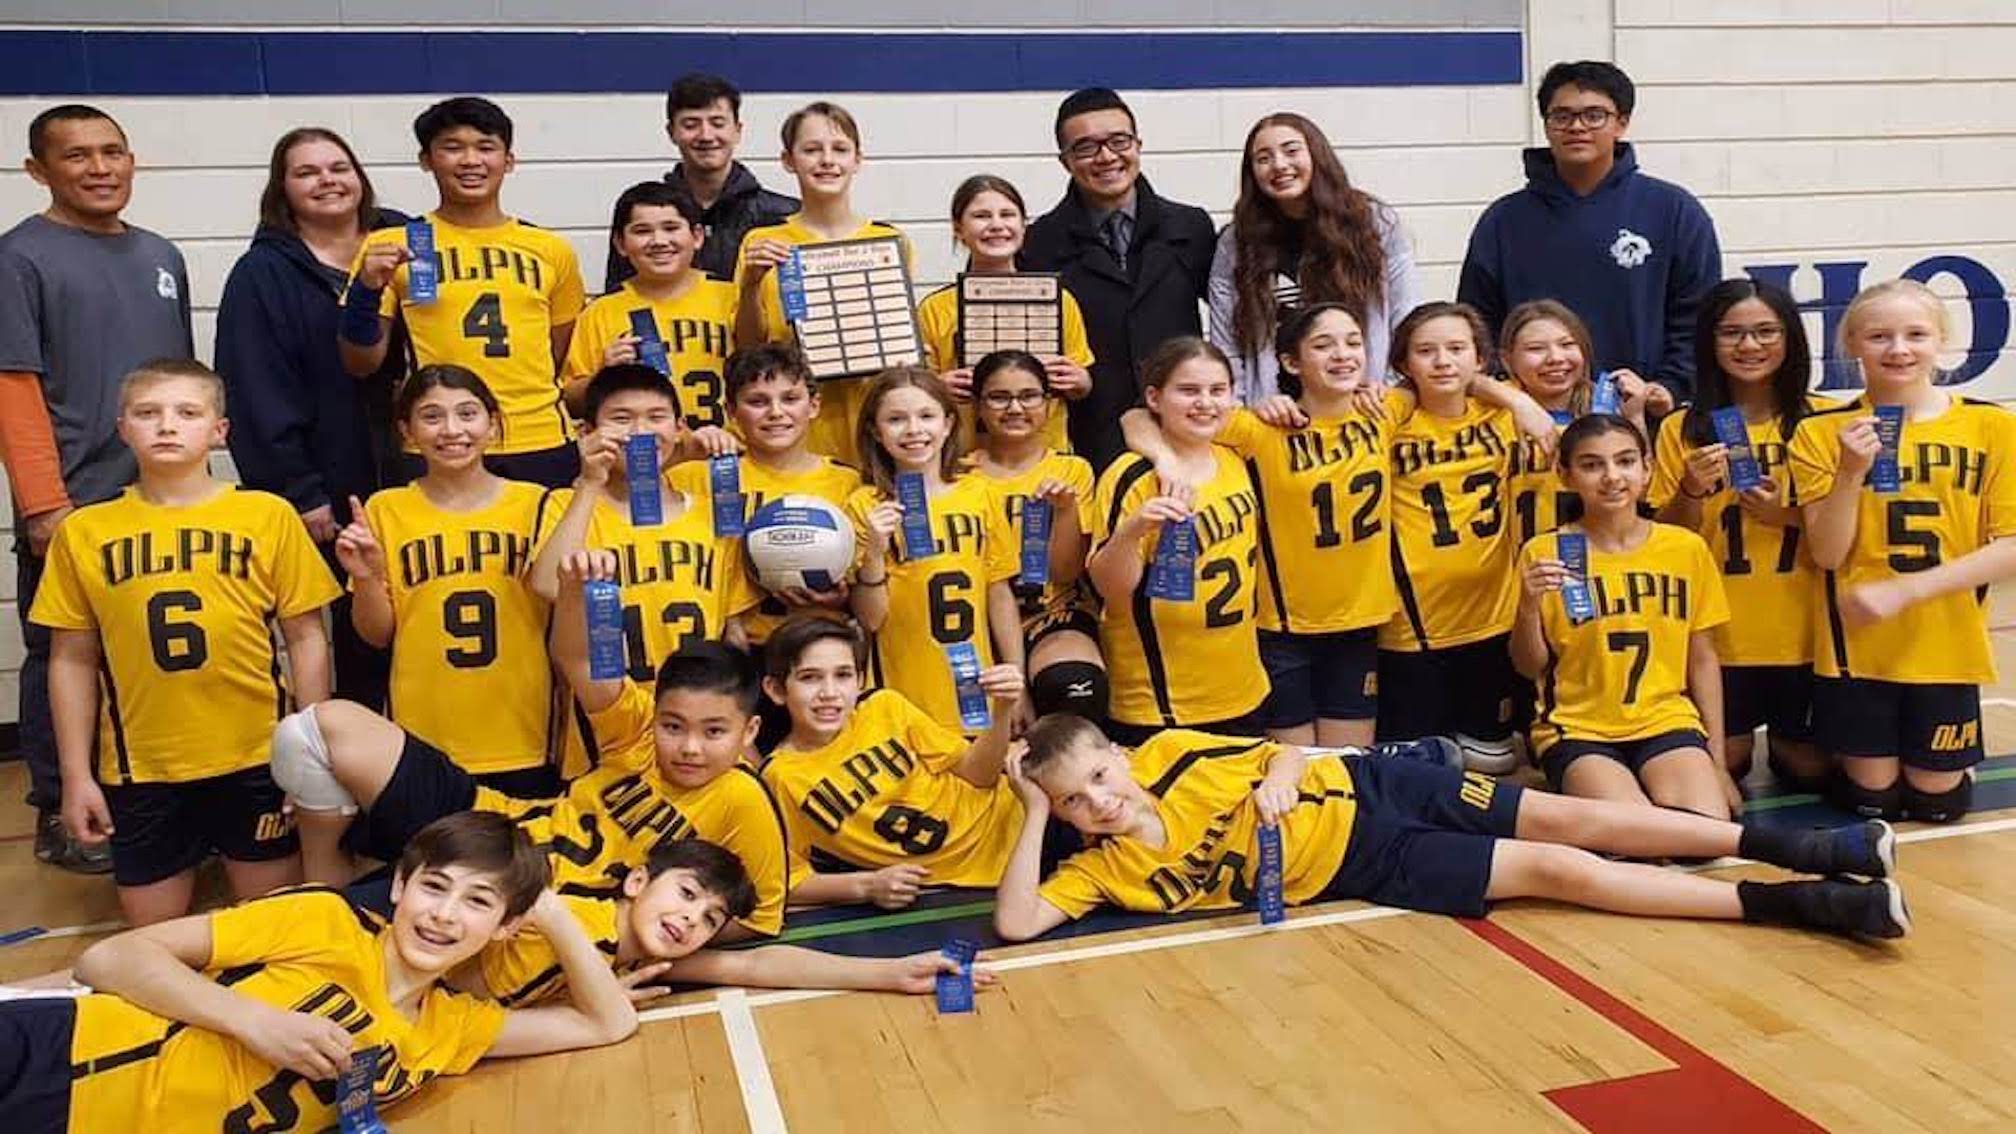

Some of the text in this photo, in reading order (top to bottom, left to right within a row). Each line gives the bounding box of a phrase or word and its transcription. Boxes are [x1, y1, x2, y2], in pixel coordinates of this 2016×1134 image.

[463, 293, 510, 358] 4
[664, 319, 727, 357] PH
[1312, 470, 1382, 548] 12
[1421, 471, 1501, 547] 13
[1887, 500, 1941, 573] 5
[102, 529, 255, 586] OLPH
[401, 531, 532, 587] OLPH
[1201, 545, 1257, 628] 2
[147, 590, 208, 673] 6
[442, 590, 498, 669] 9
[928, 571, 974, 643] 6
[1573, 571, 1686, 625] LPH
[1608, 632, 1649, 704] 7
[801, 737, 915, 834] OLPH
[873, 804, 949, 856] 8
